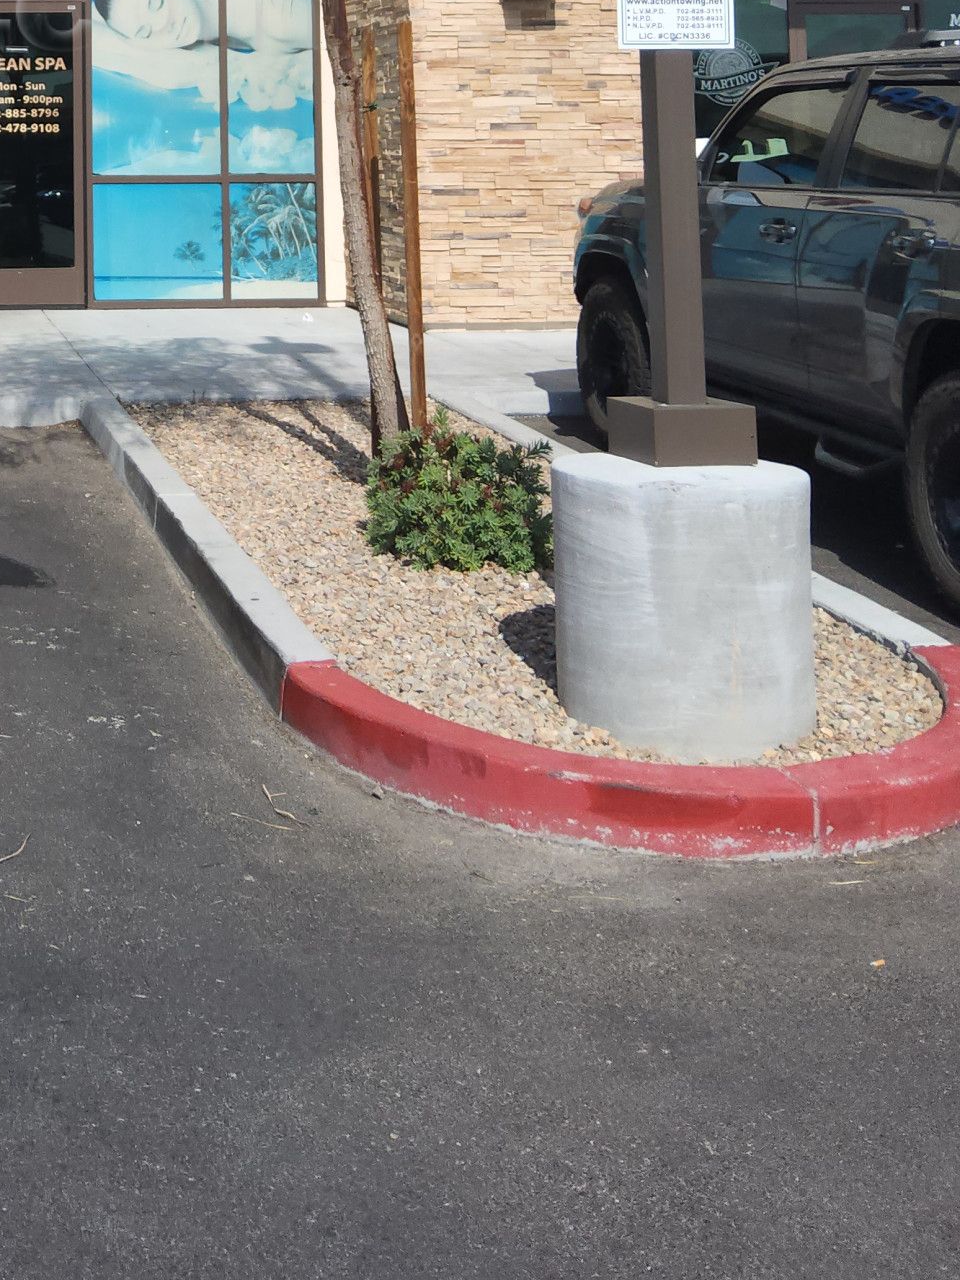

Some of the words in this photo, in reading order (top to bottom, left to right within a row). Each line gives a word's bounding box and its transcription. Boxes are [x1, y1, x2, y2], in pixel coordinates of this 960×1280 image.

[34, 57, 67, 71] SPA
[25, 81, 46, 91] Sun
[700, 69, 766, 91] MARTINO'S
[22, 95, 64, 106] 9:00pm
